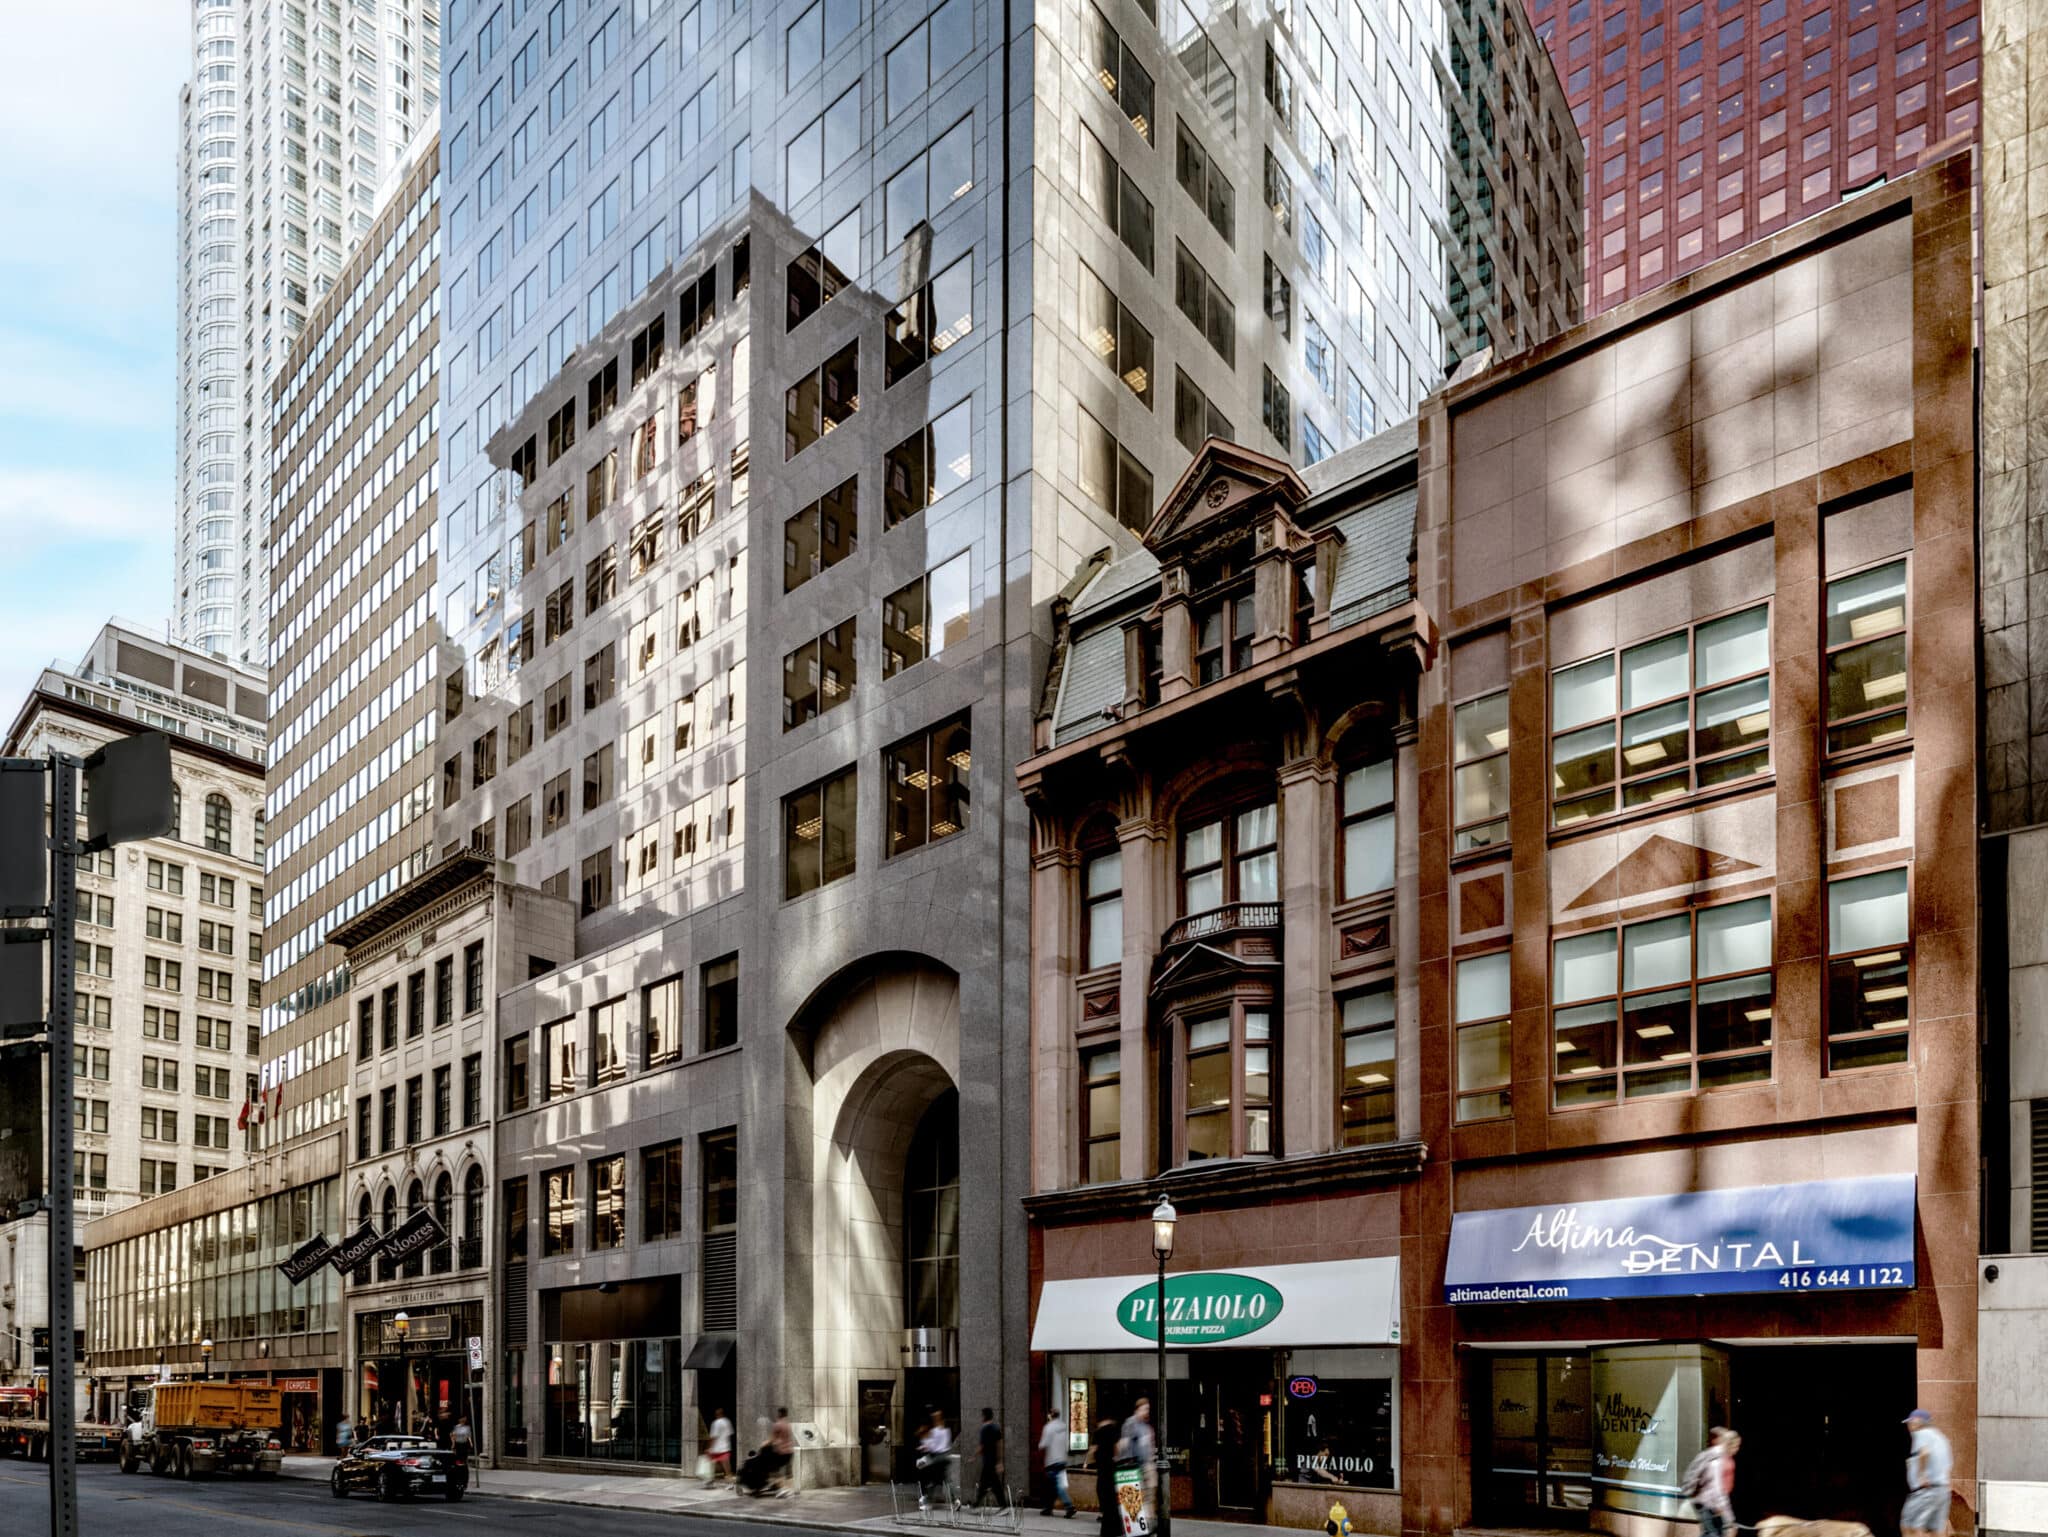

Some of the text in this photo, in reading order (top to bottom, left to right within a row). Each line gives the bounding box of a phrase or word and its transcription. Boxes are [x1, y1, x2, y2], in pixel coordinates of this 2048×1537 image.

[386, 1222, 434, 1259] Moores
[1512, 1208, 1650, 1254] Altima
[284, 1246, 328, 1278] Moores
[332, 1232, 377, 1267] Moores
[1624, 1240, 1815, 1274] DENTAL
[1779, 1267, 1903, 1287] 416 644 1122
[1450, 1285, 1569, 1302] altimadental.com
[1164, 1325, 1225, 1336] OURMET PIZZA
[1291, 1381, 1315, 1394] OPEN
[1602, 1393, 1652, 1420] Altima
[1297, 1454, 1374, 1473] PIZZAIOLO
